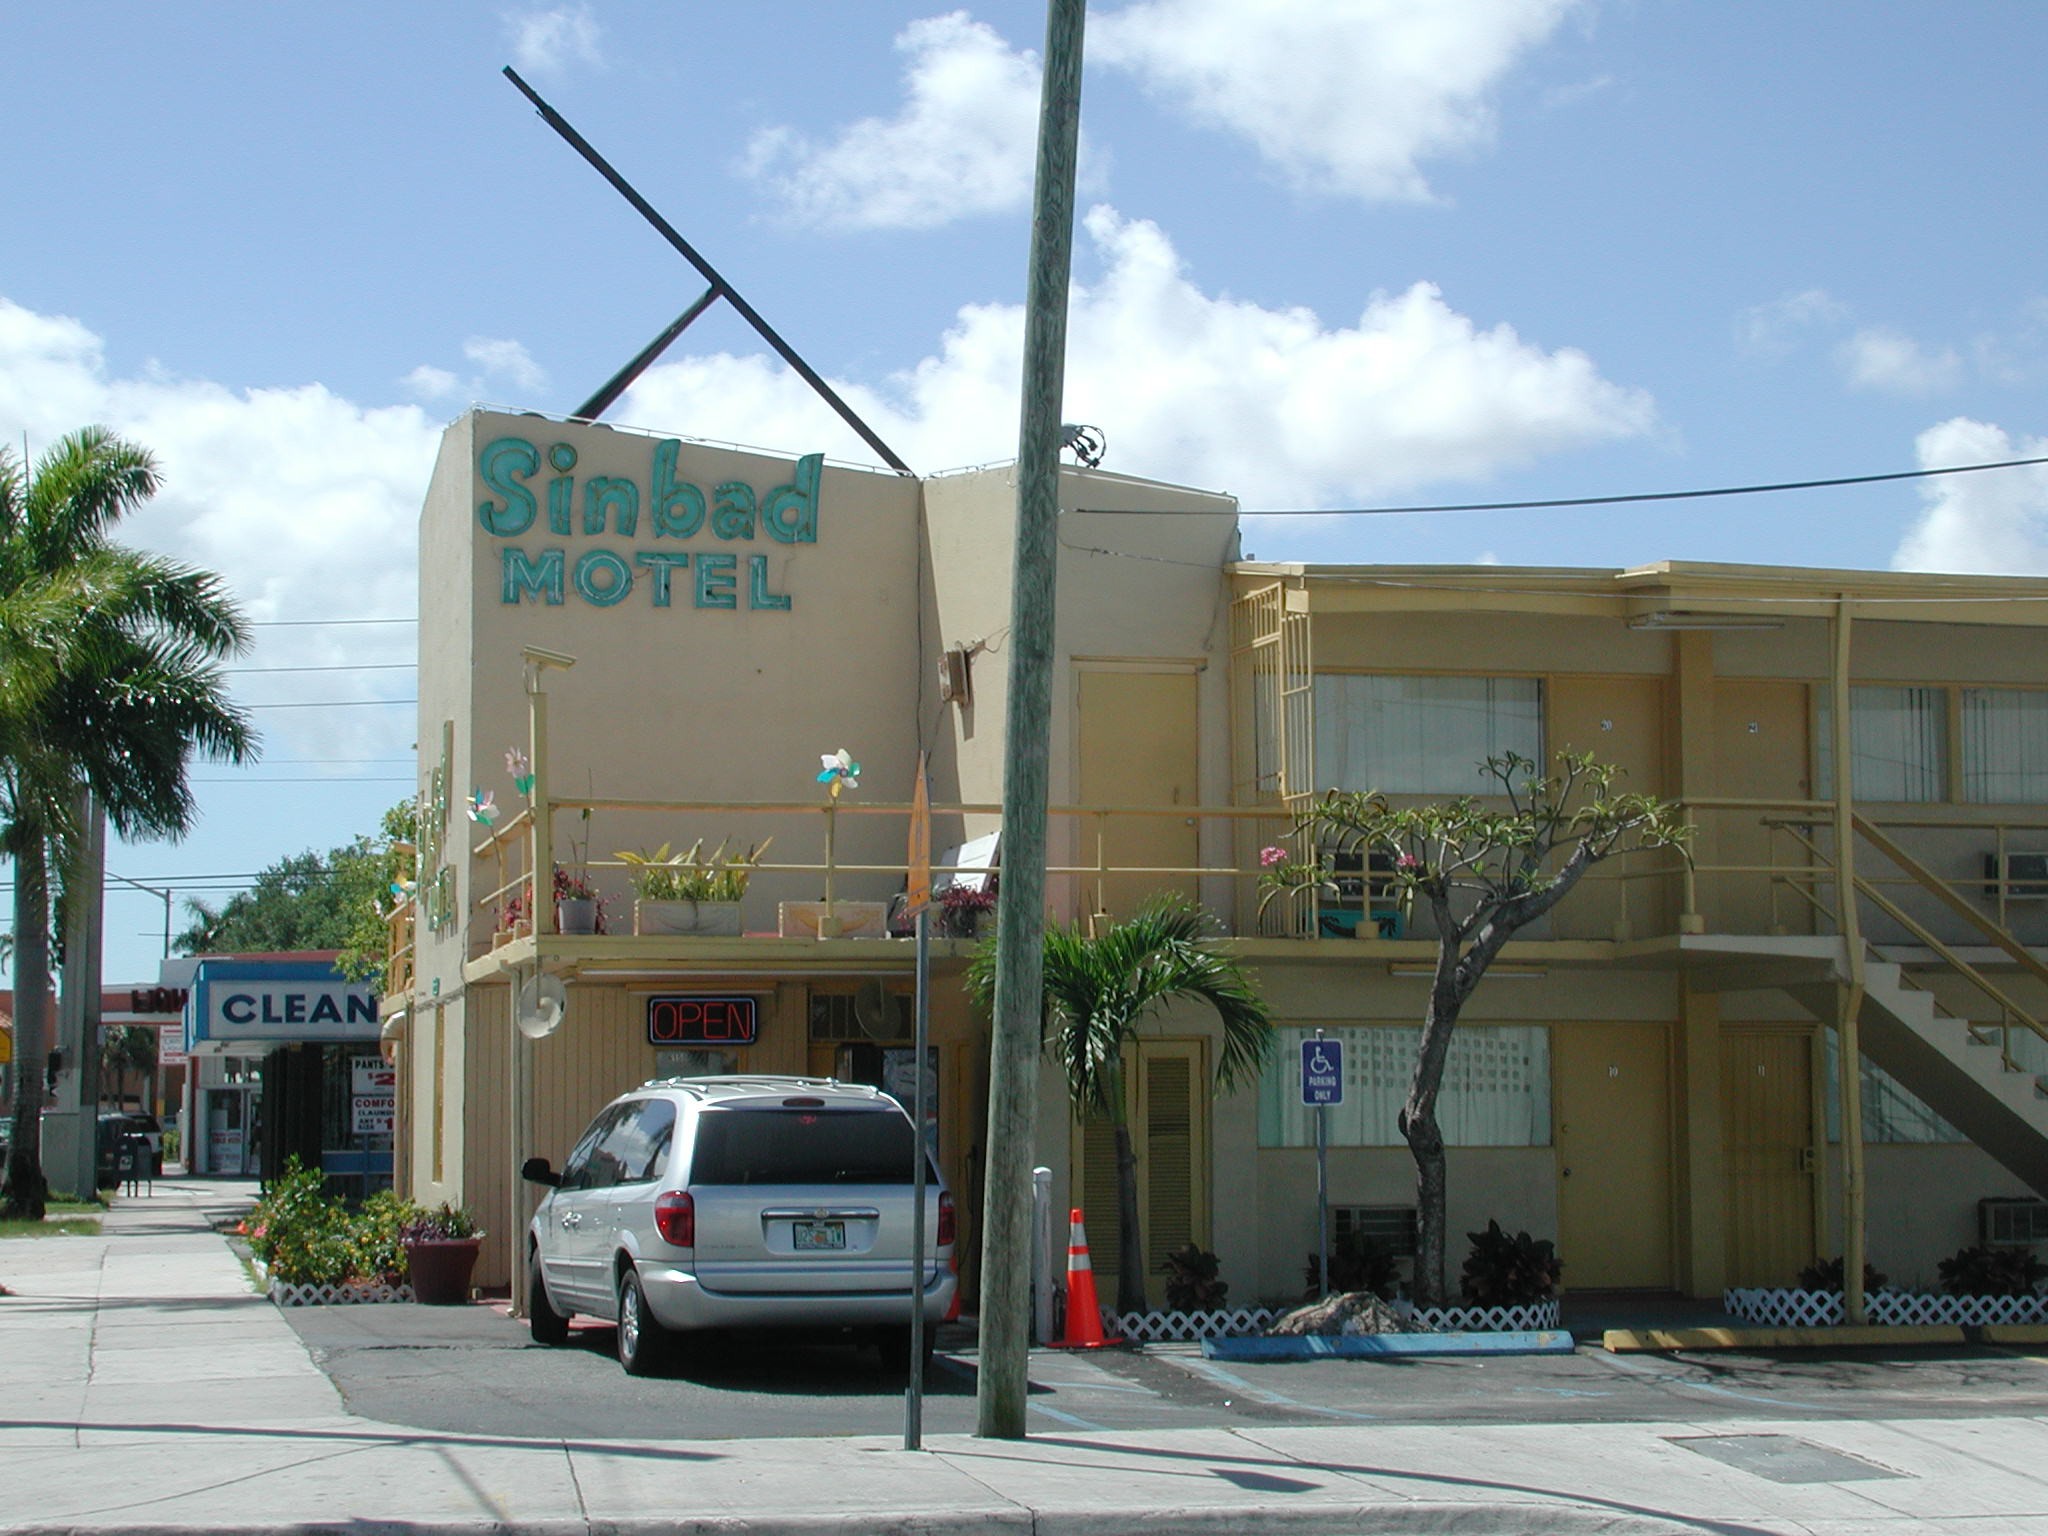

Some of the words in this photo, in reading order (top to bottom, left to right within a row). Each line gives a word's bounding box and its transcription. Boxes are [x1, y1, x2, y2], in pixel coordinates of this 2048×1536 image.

[479, 437, 825, 544] Sinbad
[502, 548, 793, 611] MOTEL
[222, 993, 378, 1024] CLEAN
[654, 1002, 750, 1039] OPEN
[355, 1059, 385, 1069] PANTS
[1308, 1076, 1337, 1087] PARKING
[1314, 1090, 1332, 1101] ONLY
